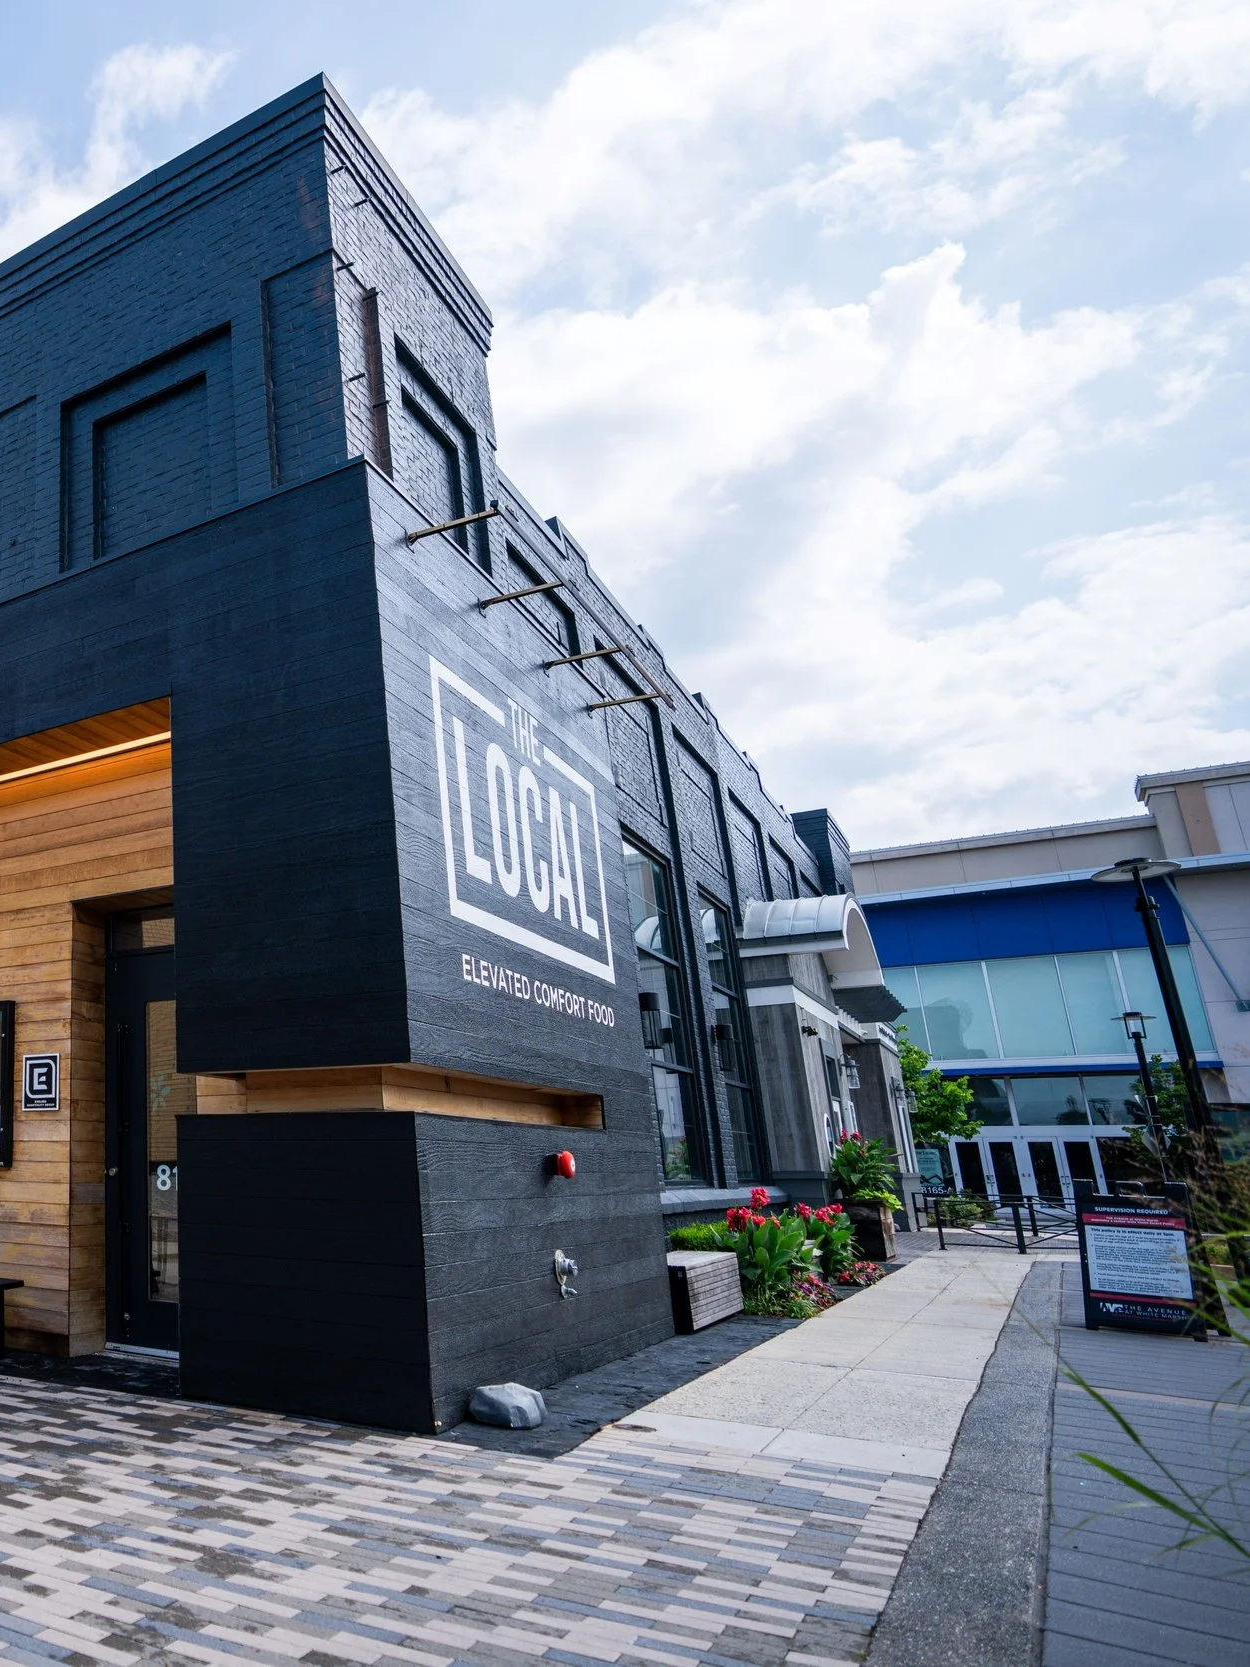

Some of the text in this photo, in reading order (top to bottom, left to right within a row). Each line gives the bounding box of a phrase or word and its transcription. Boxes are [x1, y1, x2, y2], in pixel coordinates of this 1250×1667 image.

[507, 698, 541, 765] THE
[453, 715, 600, 940] LOCAL
[462, 953, 615, 1028] ELEVATED COMFORT FOOD
[1094, 1206, 1135, 1214] SUPERVISION
[1147, 1307, 1187, 1316] AVENUE
